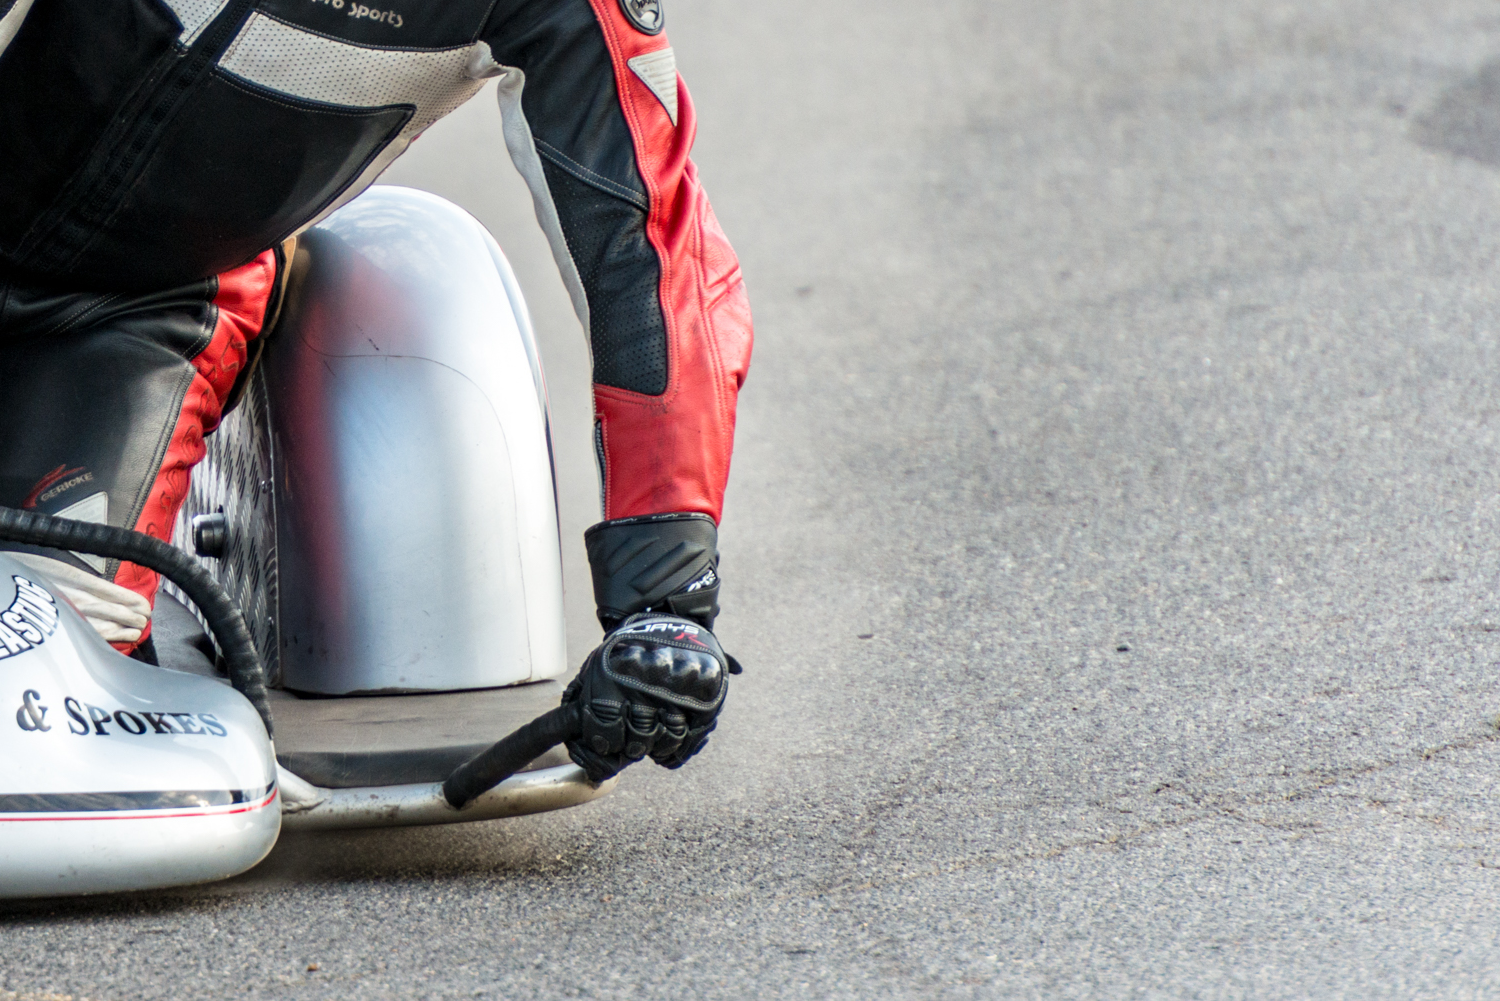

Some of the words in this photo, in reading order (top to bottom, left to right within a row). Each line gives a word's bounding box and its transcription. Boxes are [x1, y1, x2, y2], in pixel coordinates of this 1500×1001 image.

[41, 472, 94, 501] GERICKE
[15, 688, 52, 733] &
[63, 695, 229, 738] SPOKES
